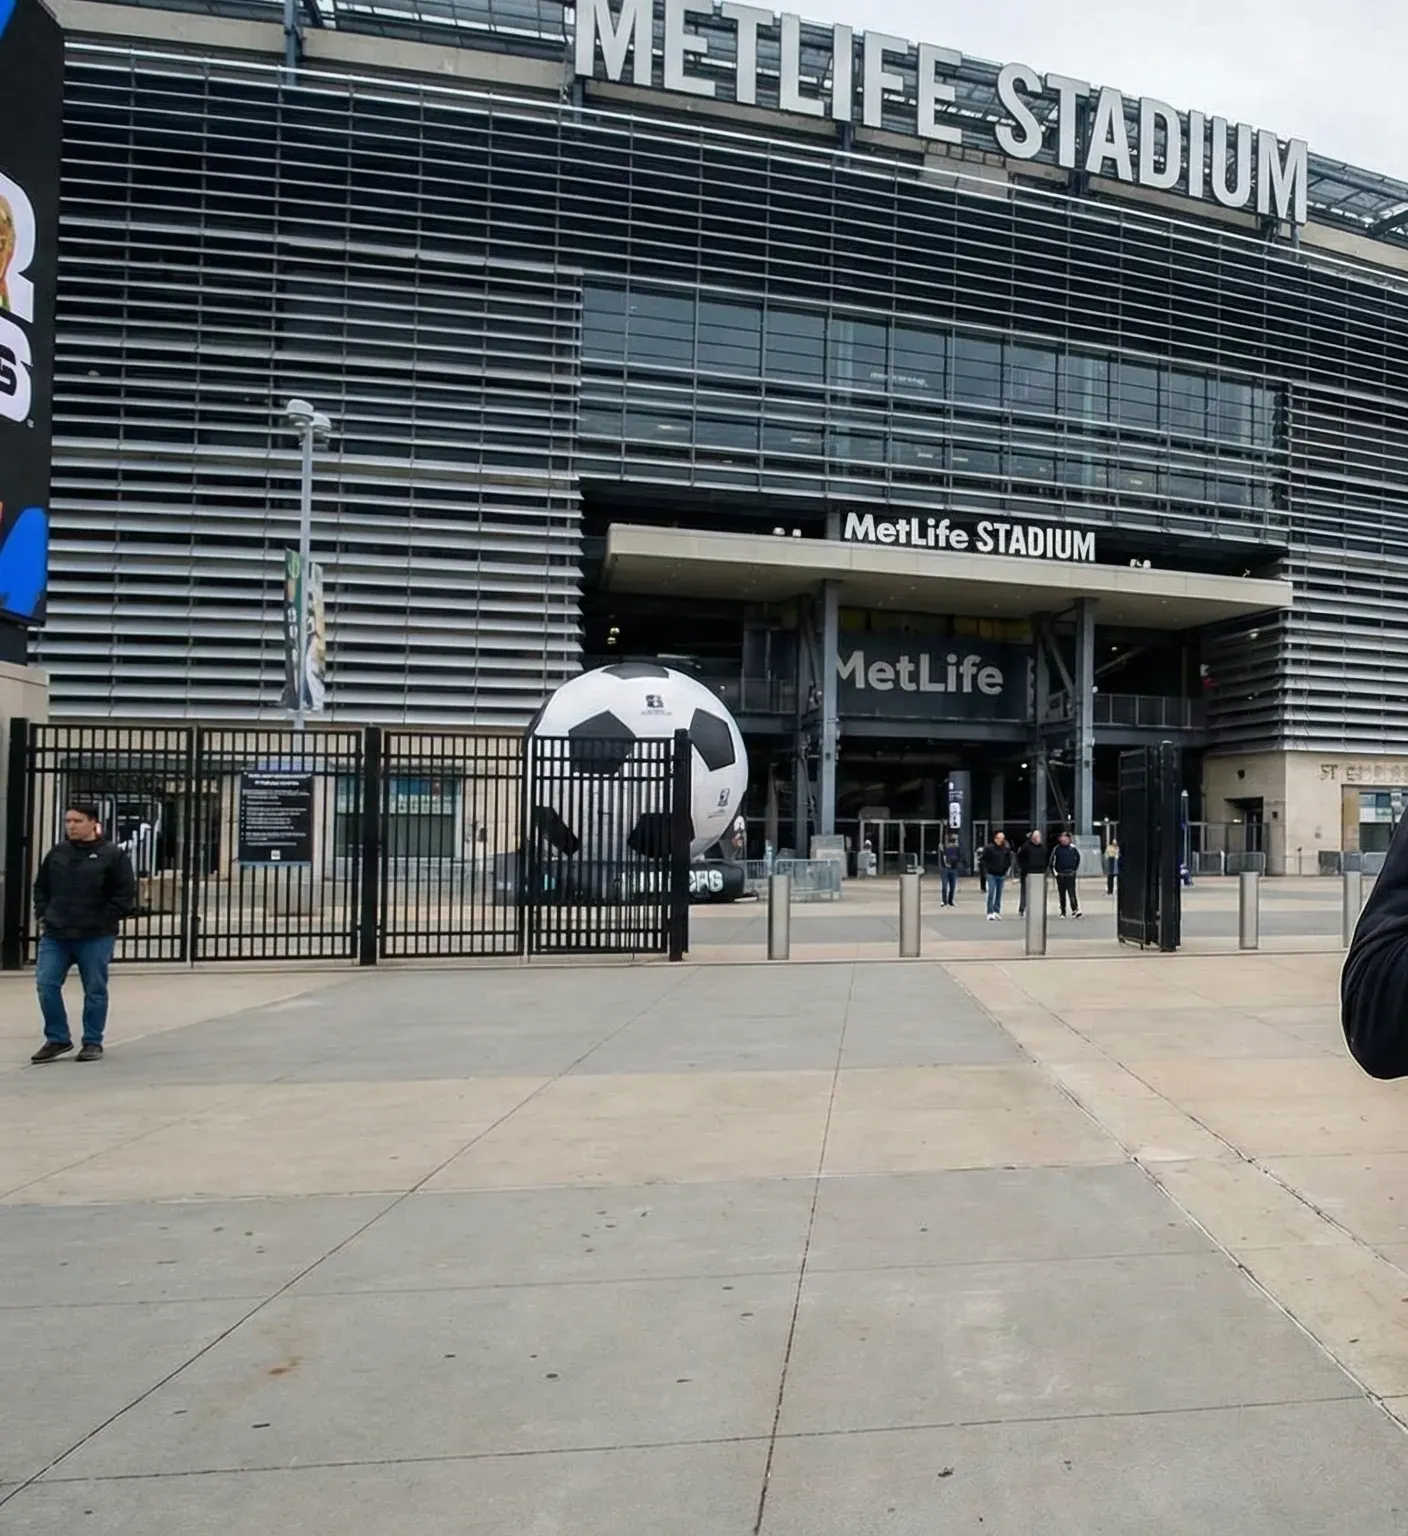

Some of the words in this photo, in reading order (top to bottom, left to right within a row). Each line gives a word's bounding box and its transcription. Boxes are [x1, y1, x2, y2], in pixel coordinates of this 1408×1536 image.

[575, 0, 962, 144] METLIFE
[995, 62, 1308, 224] STADIUM
[844, 512, 969, 549] MetLife
[976, 520, 1096, 562] STADIUM
[836, 650, 1003, 694] MetLife
